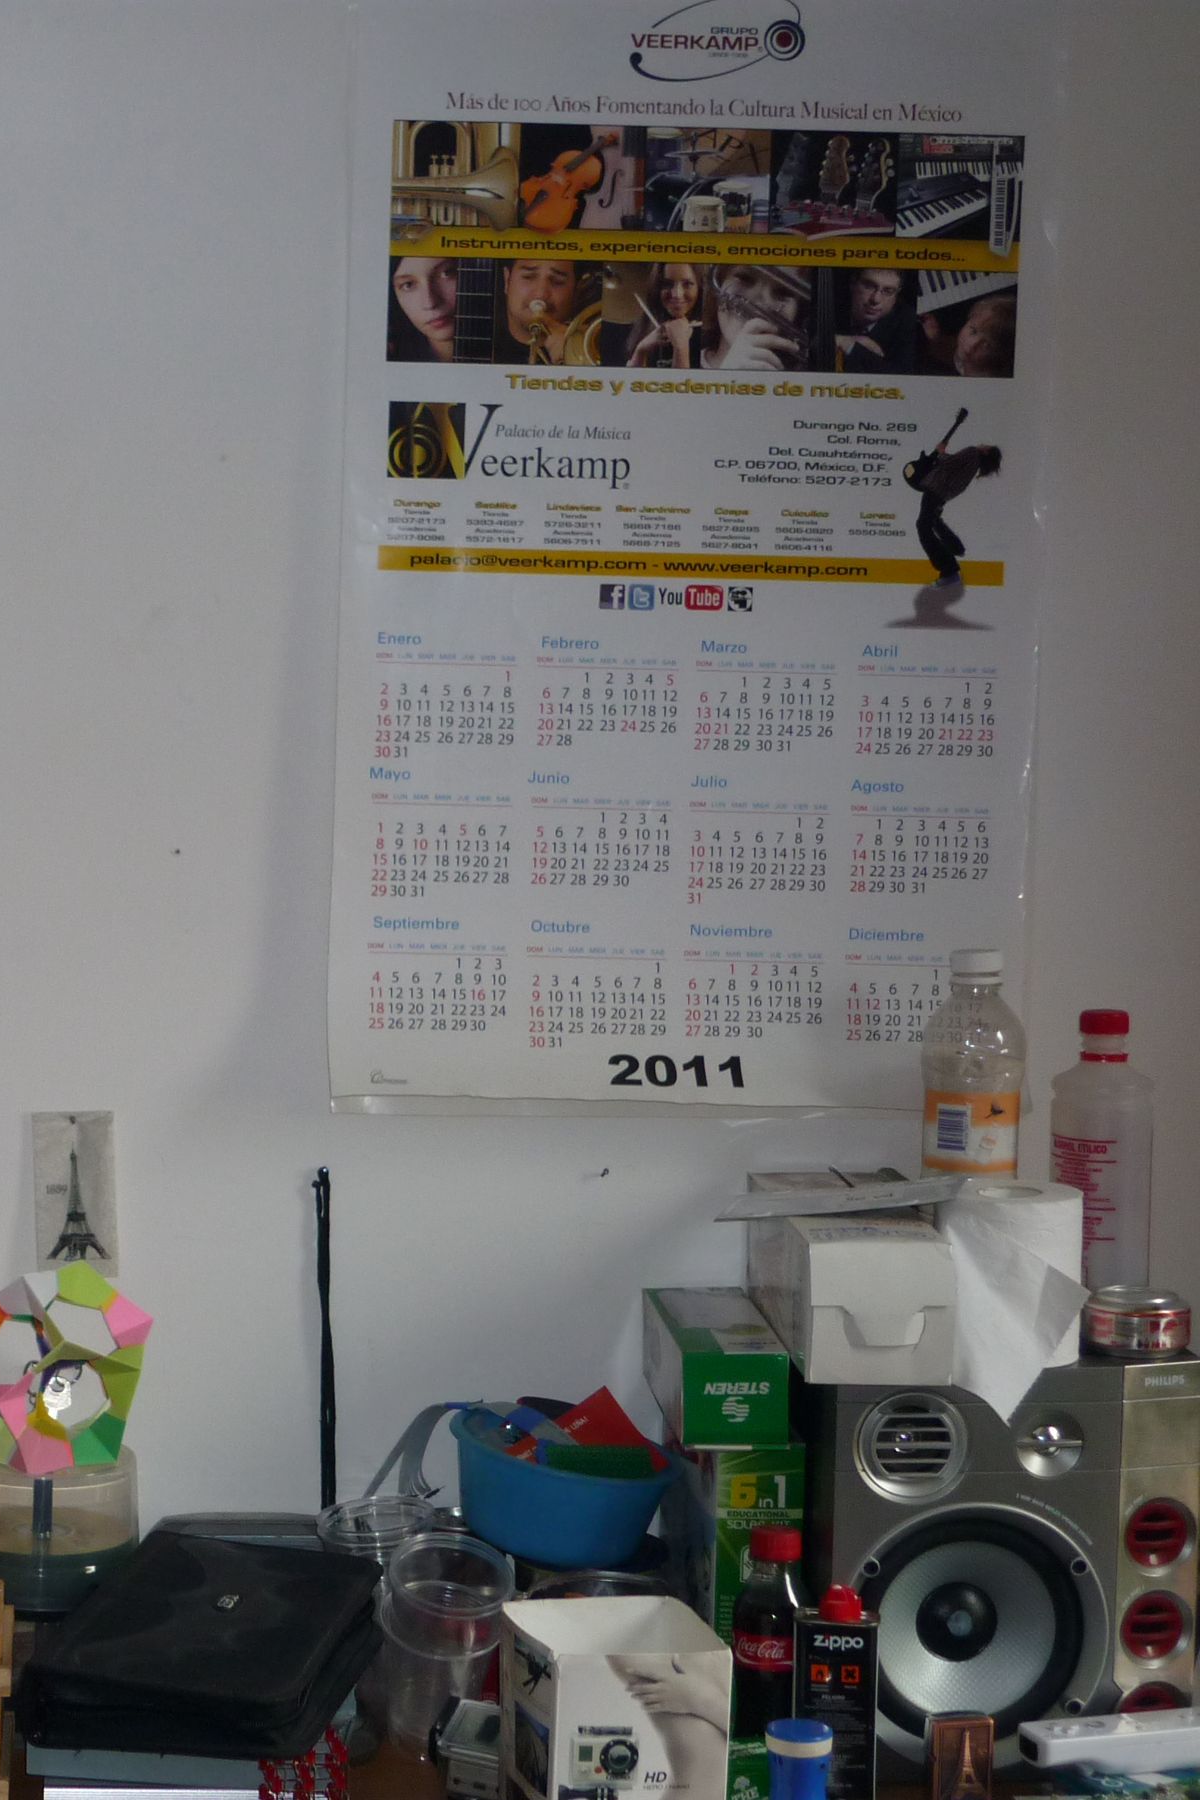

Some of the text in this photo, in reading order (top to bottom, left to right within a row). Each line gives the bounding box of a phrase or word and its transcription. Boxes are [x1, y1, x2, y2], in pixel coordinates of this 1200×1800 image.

[710, 26, 758, 35] GRUPO
[631, 33, 758, 51] VEERKAMP
[446, 92, 482, 110] Más
[488, 93, 509, 110] de
[546, 95, 590, 113] Años
[596, 95, 705, 116] Fomentando
[710, 99, 724, 117] la
[729, 99, 795, 118] Cultura
[800, 101, 868, 120] Musical
[872, 107, 893, 121] en
[898, 103, 962, 123] México
[441, 236, 583, 252] Instrumentos,
[590, 239, 721, 256] experiencias,
[727, 243, 836, 258] emociones
[842, 249, 889, 261] para
[505, 374, 905, 400] Tiendas y academias de música.
[495, 424, 631, 441] Palacio de la Música
[793, 420, 917, 433] Durango No. 269
[827, 434, 901, 446] Col. Roma,
[768, 446, 893, 461] Del. Cuauhtémoc,
[714, 460, 888, 473] C.P. 06700, México, D.F.
[738, 473, 892, 487] Teléfono: 5207-2173
[393, 499, 441, 509] Durango
[663, 561, 868, 577] www.veerkamp.com
[658, 588, 683, 605] You
[688, 587, 720, 606] Tube
[377, 632, 422, 645] Enero
[541, 636, 599, 650] Febrero
[701, 640, 747, 654] Marzo
[862, 644, 898, 658] Abril
[377, 714, 515, 731] 16 17 18 19 20 21 22
[858, 710, 995, 726] 10 11 12 13 14 15 16
[369, 768, 411, 782] Mayo
[528, 771, 570, 784] Junio
[690, 776, 728, 788] Julio
[851, 779, 904, 794] Agosto
[373, 916, 460, 931] Septiembre
[531, 920, 590, 934] Octubre
[690, 924, 773, 938] Noviembre
[849, 928, 924, 942] Diciembre
[686, 993, 823, 1009] 13 14 15 16 17 18 19
[608, 1053, 745, 1089] 2011
[1144, 1375, 1185, 1387] PHILIPS
[704, 1381, 771, 1396] STEREN
[731, 1474, 786, 1509] 6 in 1
[726, 1510, 790, 1519] EDUCATIONAL
[813, 1633, 864, 1651] zippo
[644, 1771, 668, 1783] HD
